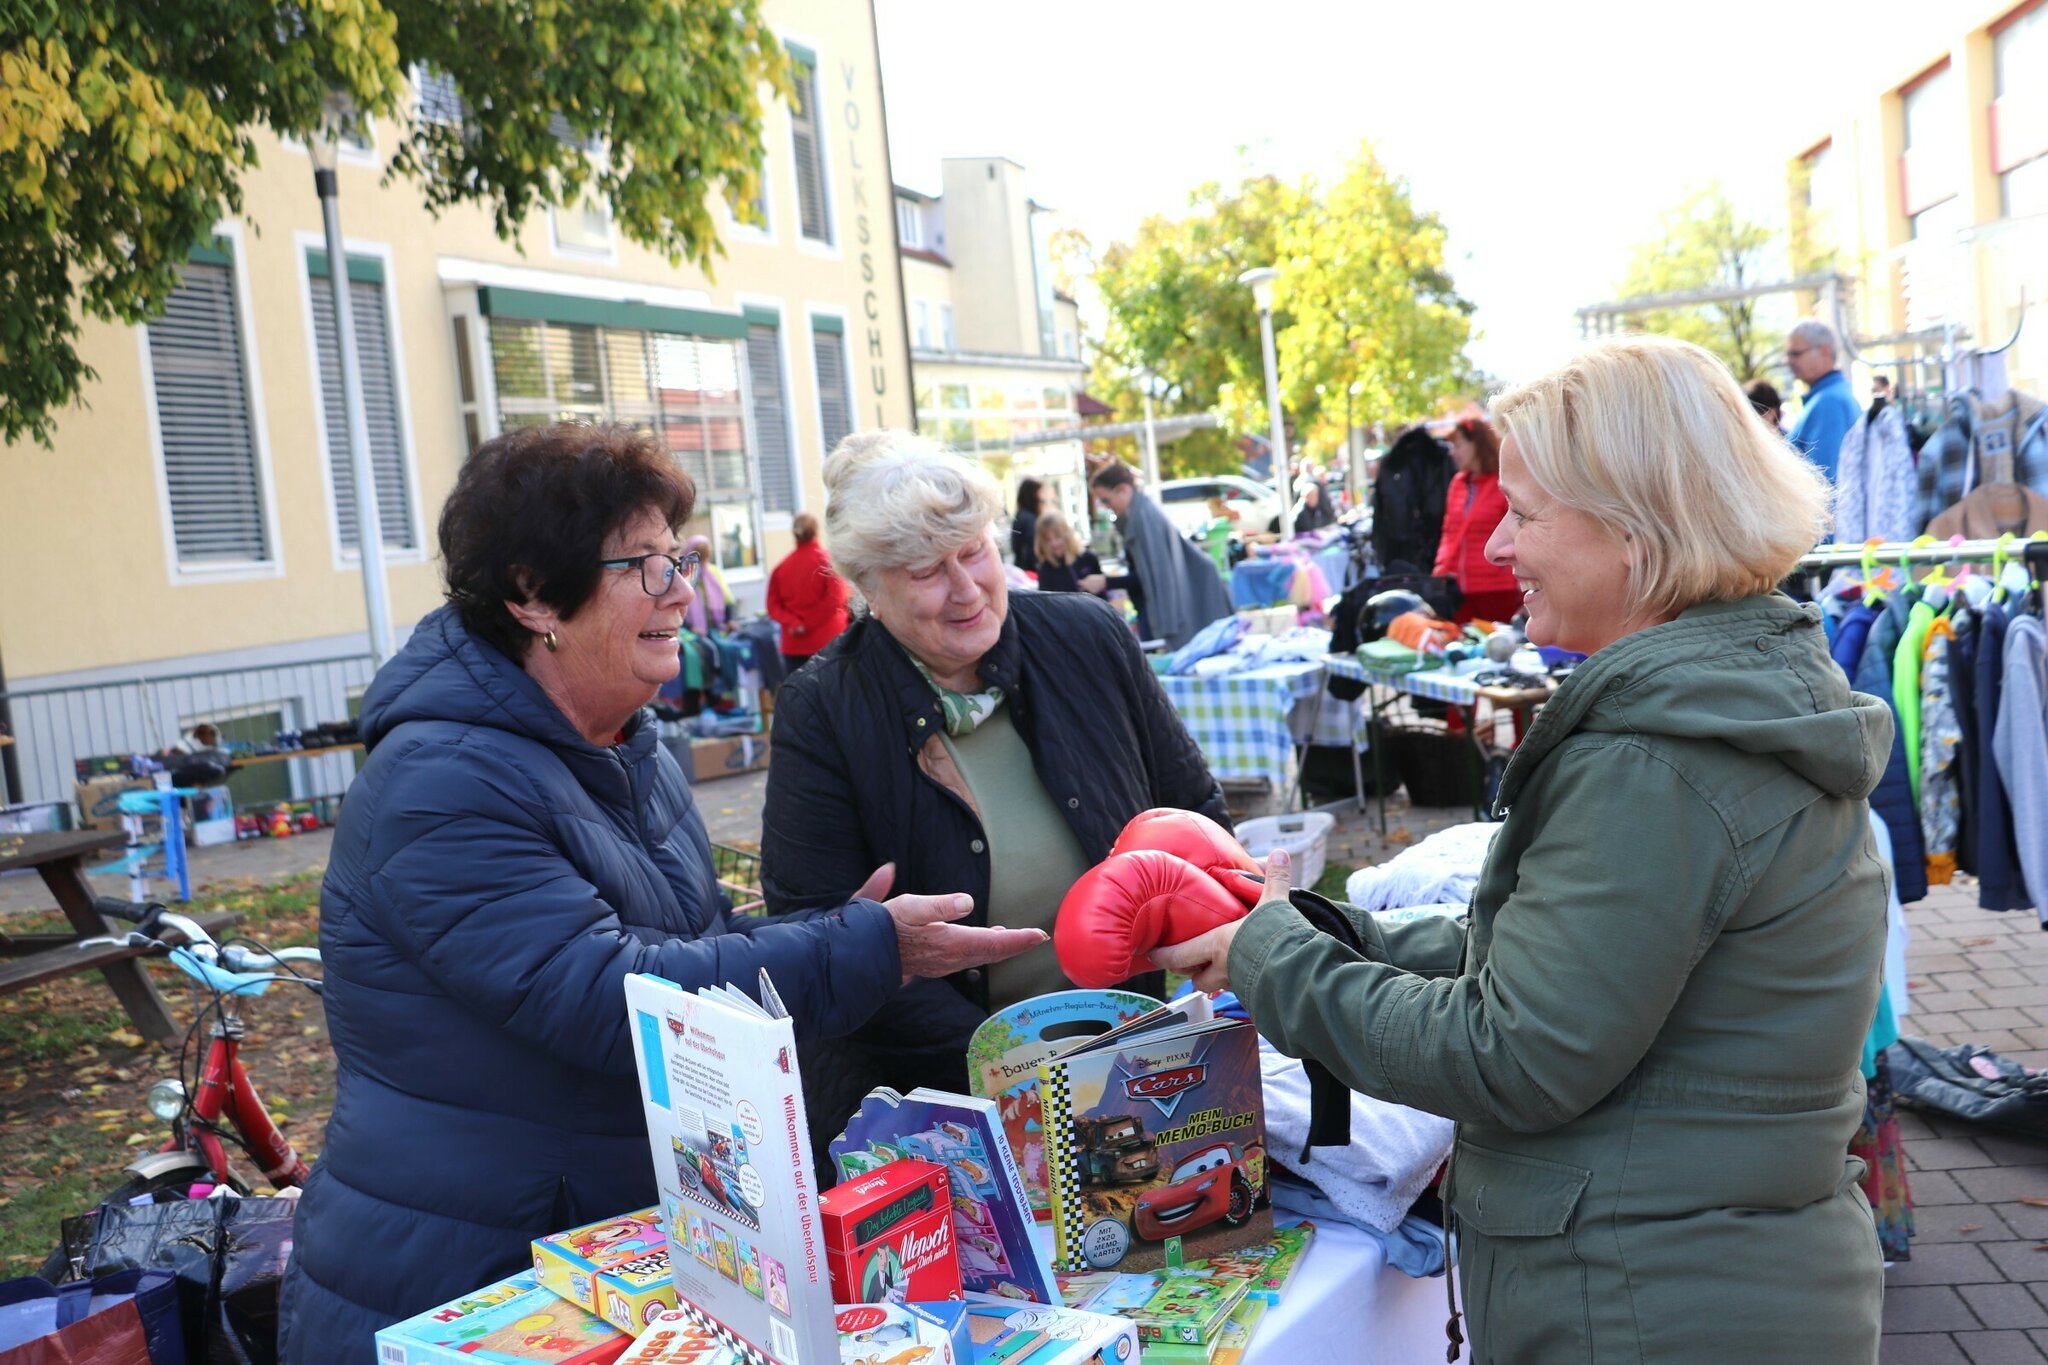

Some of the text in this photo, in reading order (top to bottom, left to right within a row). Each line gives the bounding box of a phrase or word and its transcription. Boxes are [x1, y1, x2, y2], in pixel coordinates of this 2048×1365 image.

[1136, 1052, 1192, 1069] Disney PIXAR
[1133, 1072, 1198, 1094] Cars
[1042, 1099, 1051, 1127] MEIN
[1188, 1108, 1222, 1124] MEIN
[783, 1094, 801, 1168] Willkommen
[1155, 1112, 1255, 1146] MEMO-BUCH
[997, 1134, 1005, 1145] 10
[1001, 1145, 1015, 1173] KLEINE
[1046, 1130, 1058, 1196] MEMO-BUCH
[794, 1170, 807, 1189] auf
[797, 1193, 809, 1211] der
[896, 1214, 950, 1266] Mensch
[1098, 1226, 1112, 1236] MIT
[916, 1253, 934, 1270] Dich
[1092, 1246, 1121, 1259] KARTEN
